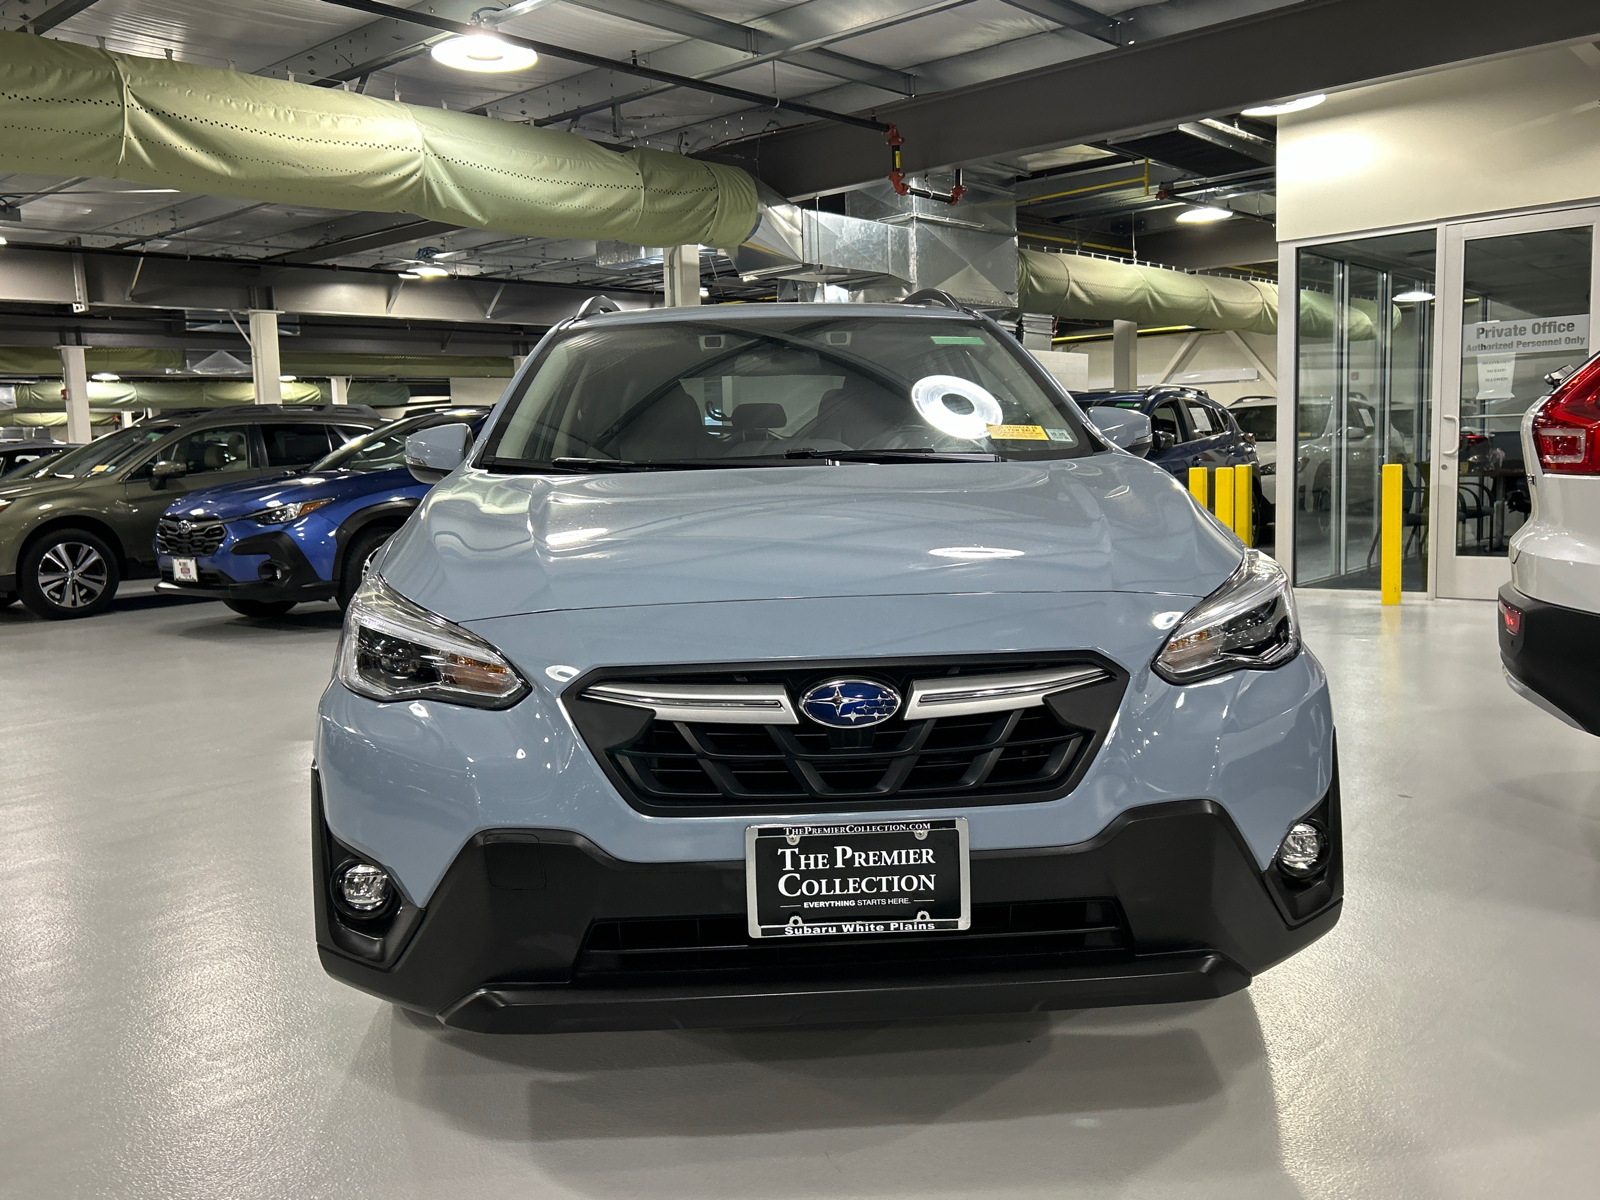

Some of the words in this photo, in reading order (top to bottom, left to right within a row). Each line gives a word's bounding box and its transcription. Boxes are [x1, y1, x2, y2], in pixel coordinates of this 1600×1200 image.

[1476, 324, 1527, 339] Private
[1531, 321, 1575, 336] Office
[1466, 341, 1514, 352] Authorized
[1516, 337, 1562, 349] Personnel
[1564, 336, 1586, 346] Only
[777, 847, 830, 871] THE
[833, 845, 936, 869] PREMIER
[777, 873, 936, 897] COLLECTION
[803, 899, 856, 909] EVERYTHING
[857, 898, 887, 907] STARTS
[887, 897, 911, 906] HERE.
[784, 925, 838, 936] Subaru
[841, 923, 885, 934] White
[890, 921, 936, 932] Plains
